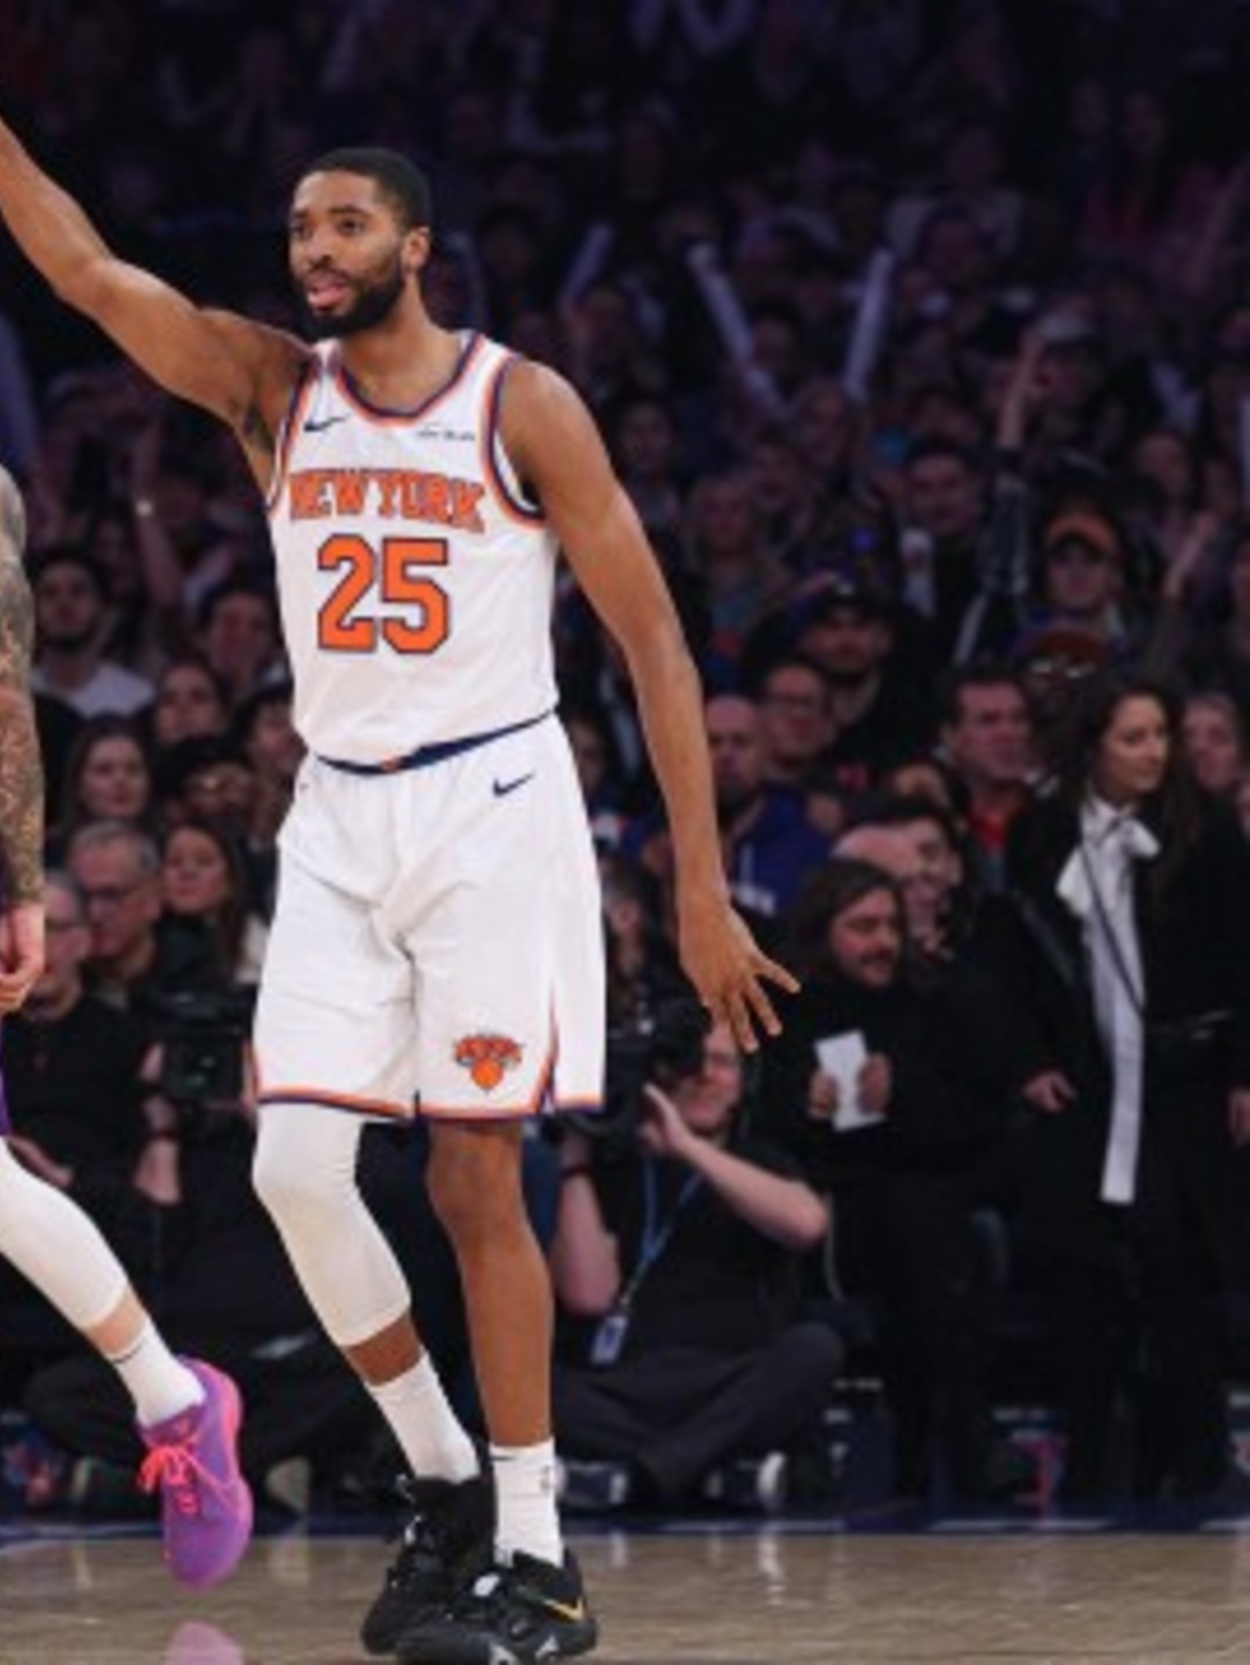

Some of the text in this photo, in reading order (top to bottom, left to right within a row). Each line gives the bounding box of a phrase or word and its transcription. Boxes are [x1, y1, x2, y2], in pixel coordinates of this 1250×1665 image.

[289, 467, 486, 534] NEW YORK
[317, 533, 449, 655] 25
